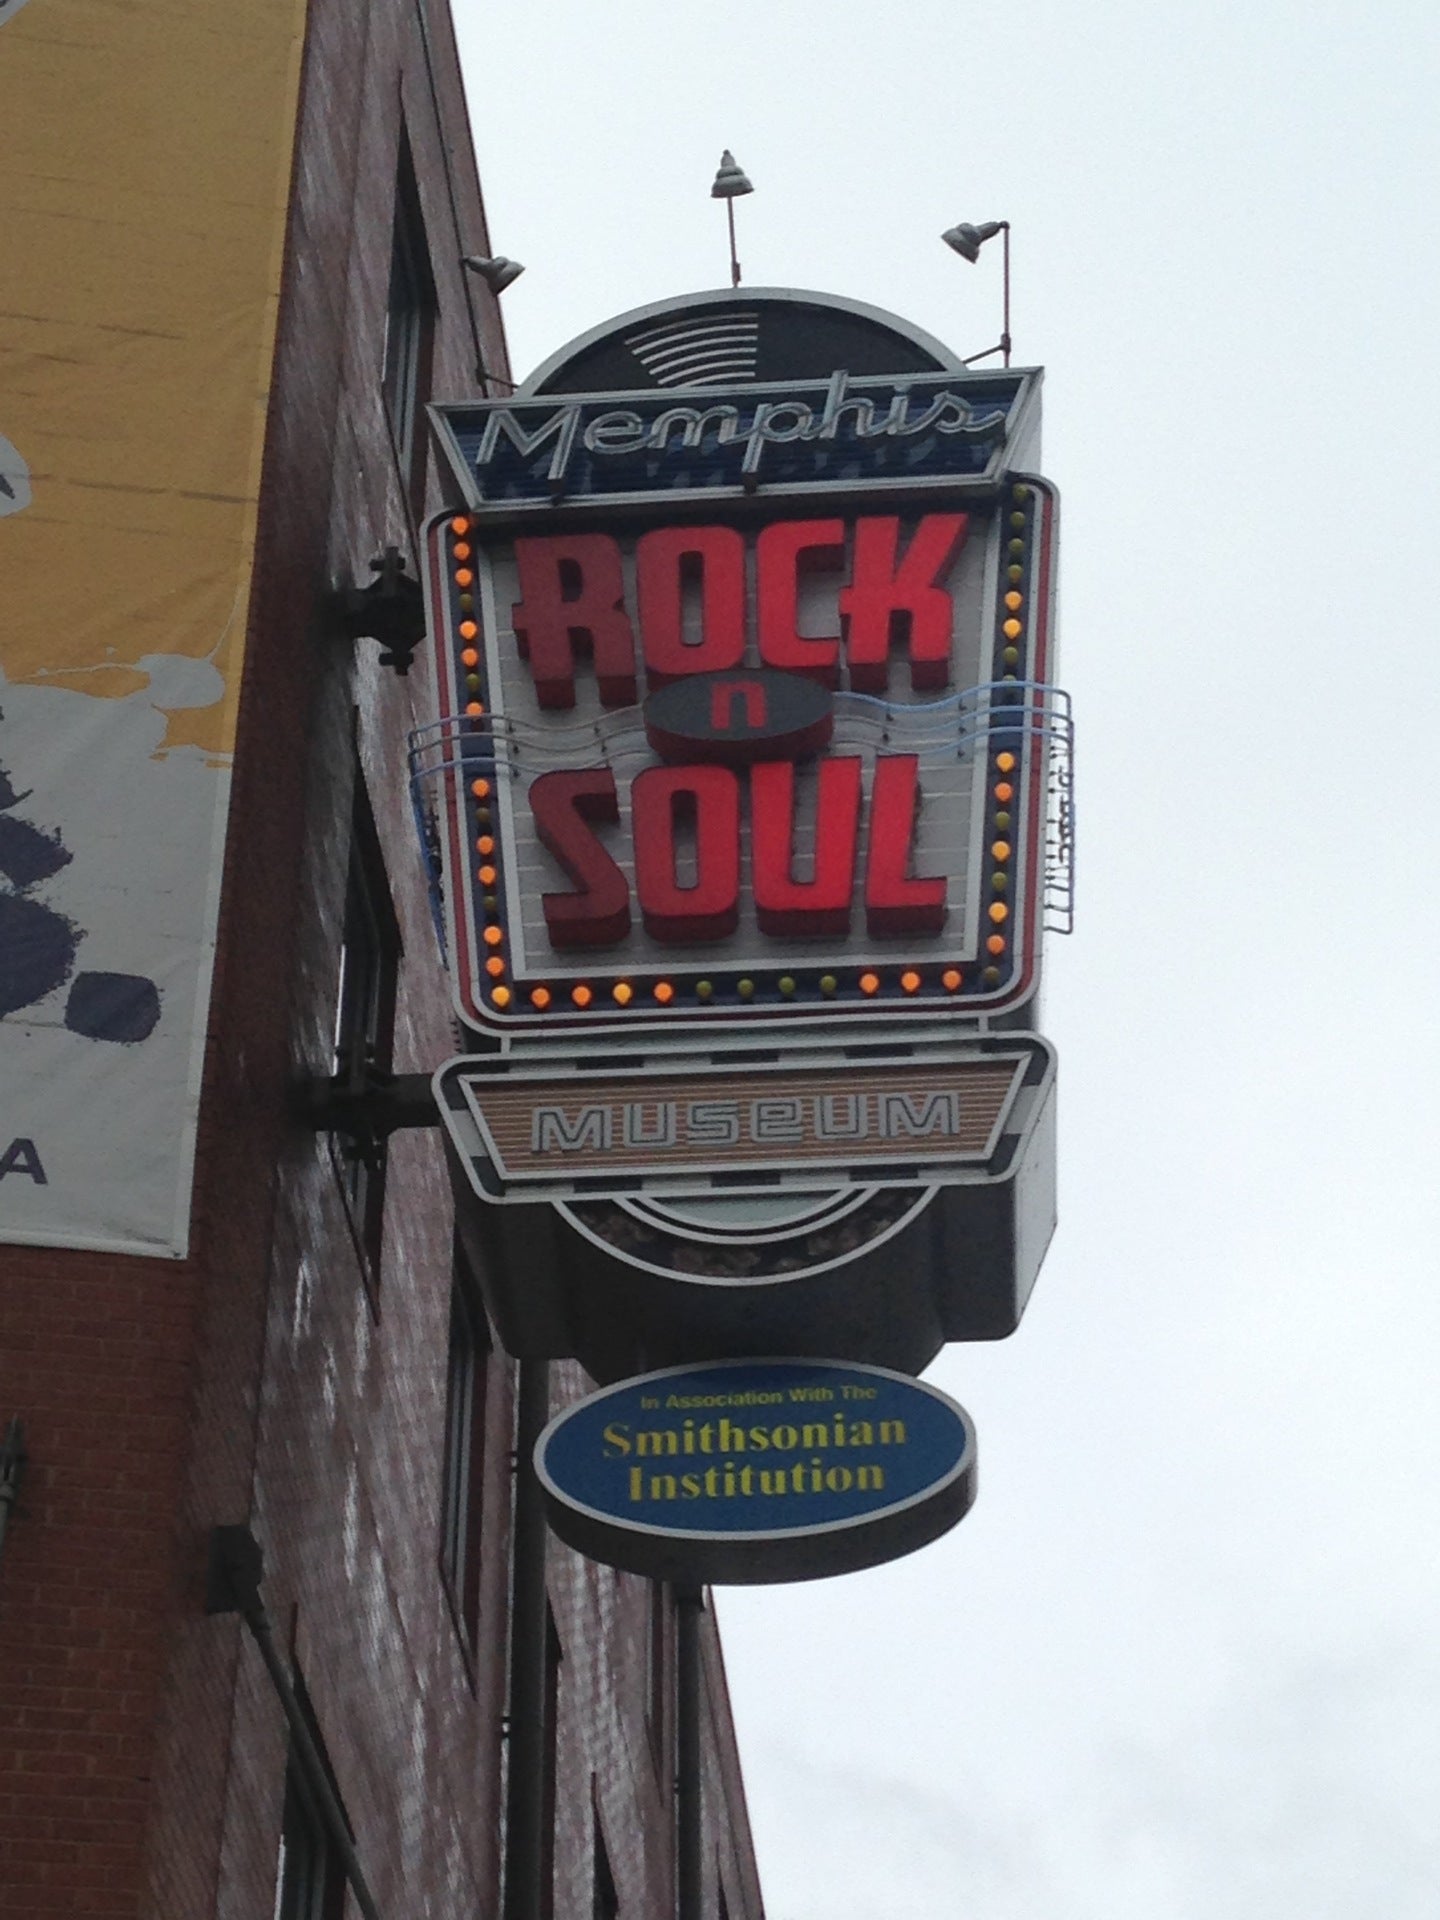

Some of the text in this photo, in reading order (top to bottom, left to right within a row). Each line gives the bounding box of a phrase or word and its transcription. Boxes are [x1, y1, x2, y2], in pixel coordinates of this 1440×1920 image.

[476, 370, 1005, 480] Memphis
[511, 513, 969, 702] ROCK
[710, 679, 766, 730] n
[528, 753, 948, 930] SOUL
[640, 1384, 877, 1409] In Association With The
[602, 1412, 907, 1459] Smithsonian
[629, 1457, 885, 1502] Institution
